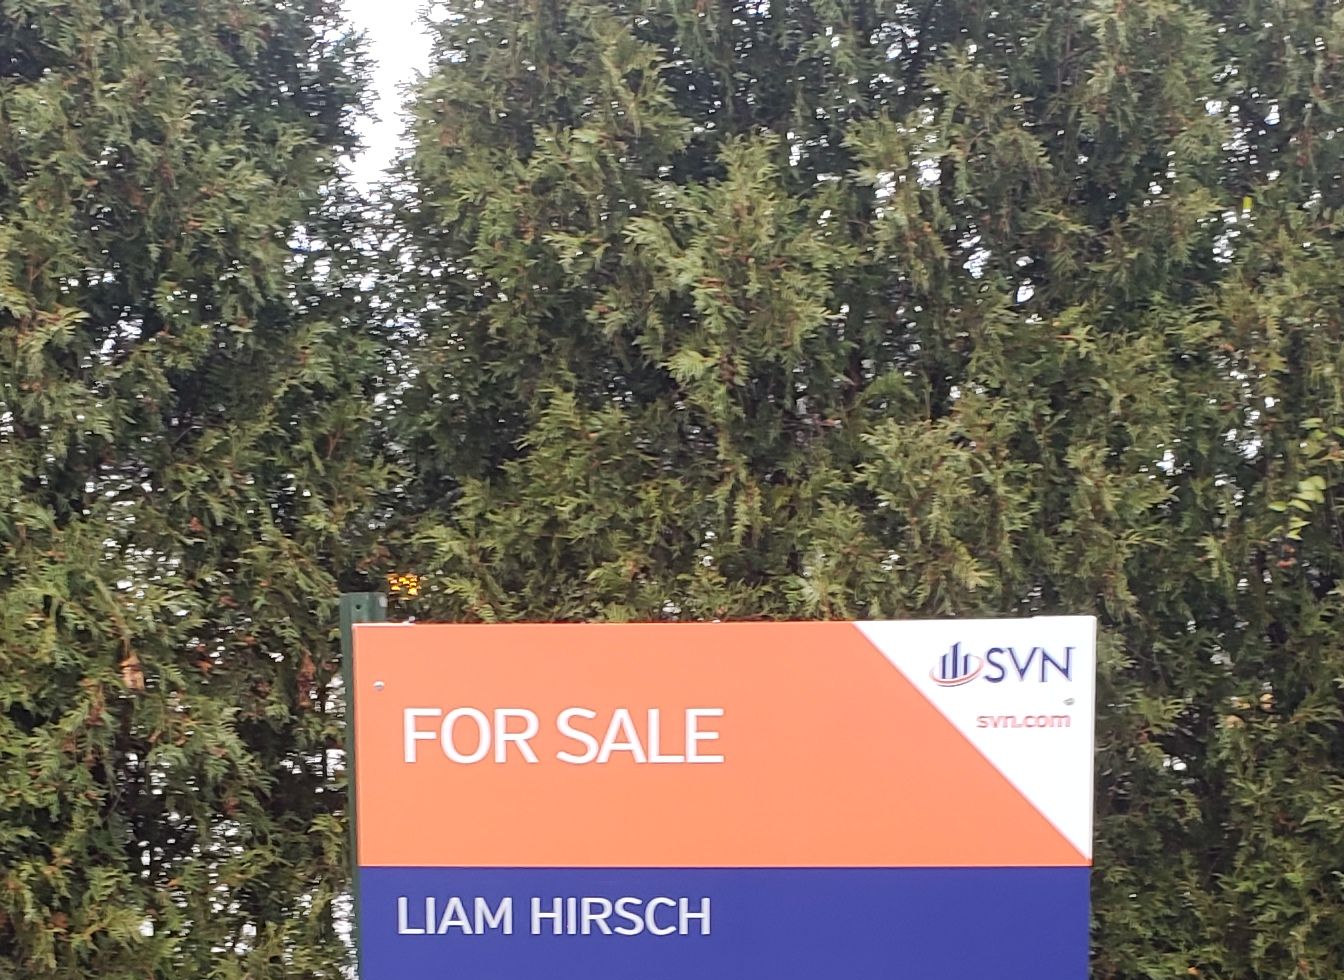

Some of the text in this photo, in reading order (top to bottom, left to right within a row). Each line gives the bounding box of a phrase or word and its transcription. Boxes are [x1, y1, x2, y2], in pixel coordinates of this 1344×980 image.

[984, 646, 1076, 683] SVN
[401, 707, 725, 765] FOR SALE
[976, 714, 1071, 729] svn.com
[396, 896, 712, 937] LIAM HIRSCH
